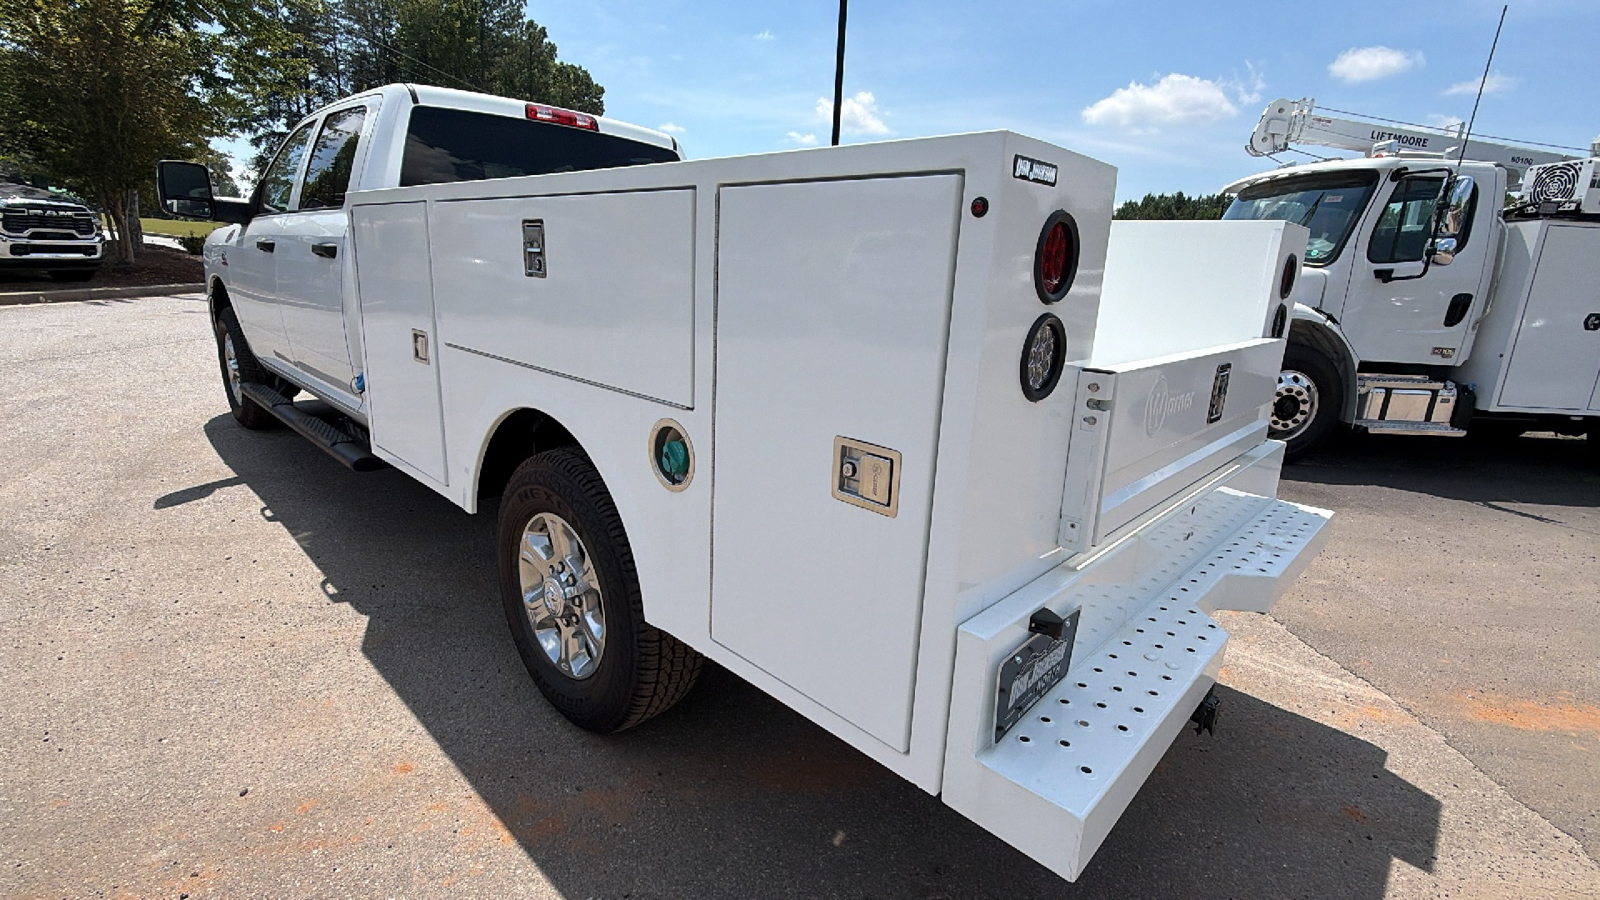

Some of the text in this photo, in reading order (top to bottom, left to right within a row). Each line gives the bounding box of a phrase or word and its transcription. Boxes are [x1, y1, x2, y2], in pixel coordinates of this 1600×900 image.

[1371, 130, 1429, 147] LIFTMOORE
[1511, 156, 1533, 165] 60100
[28, 209, 74, 217] RAM
[1146, 384, 1195, 433] Warner
